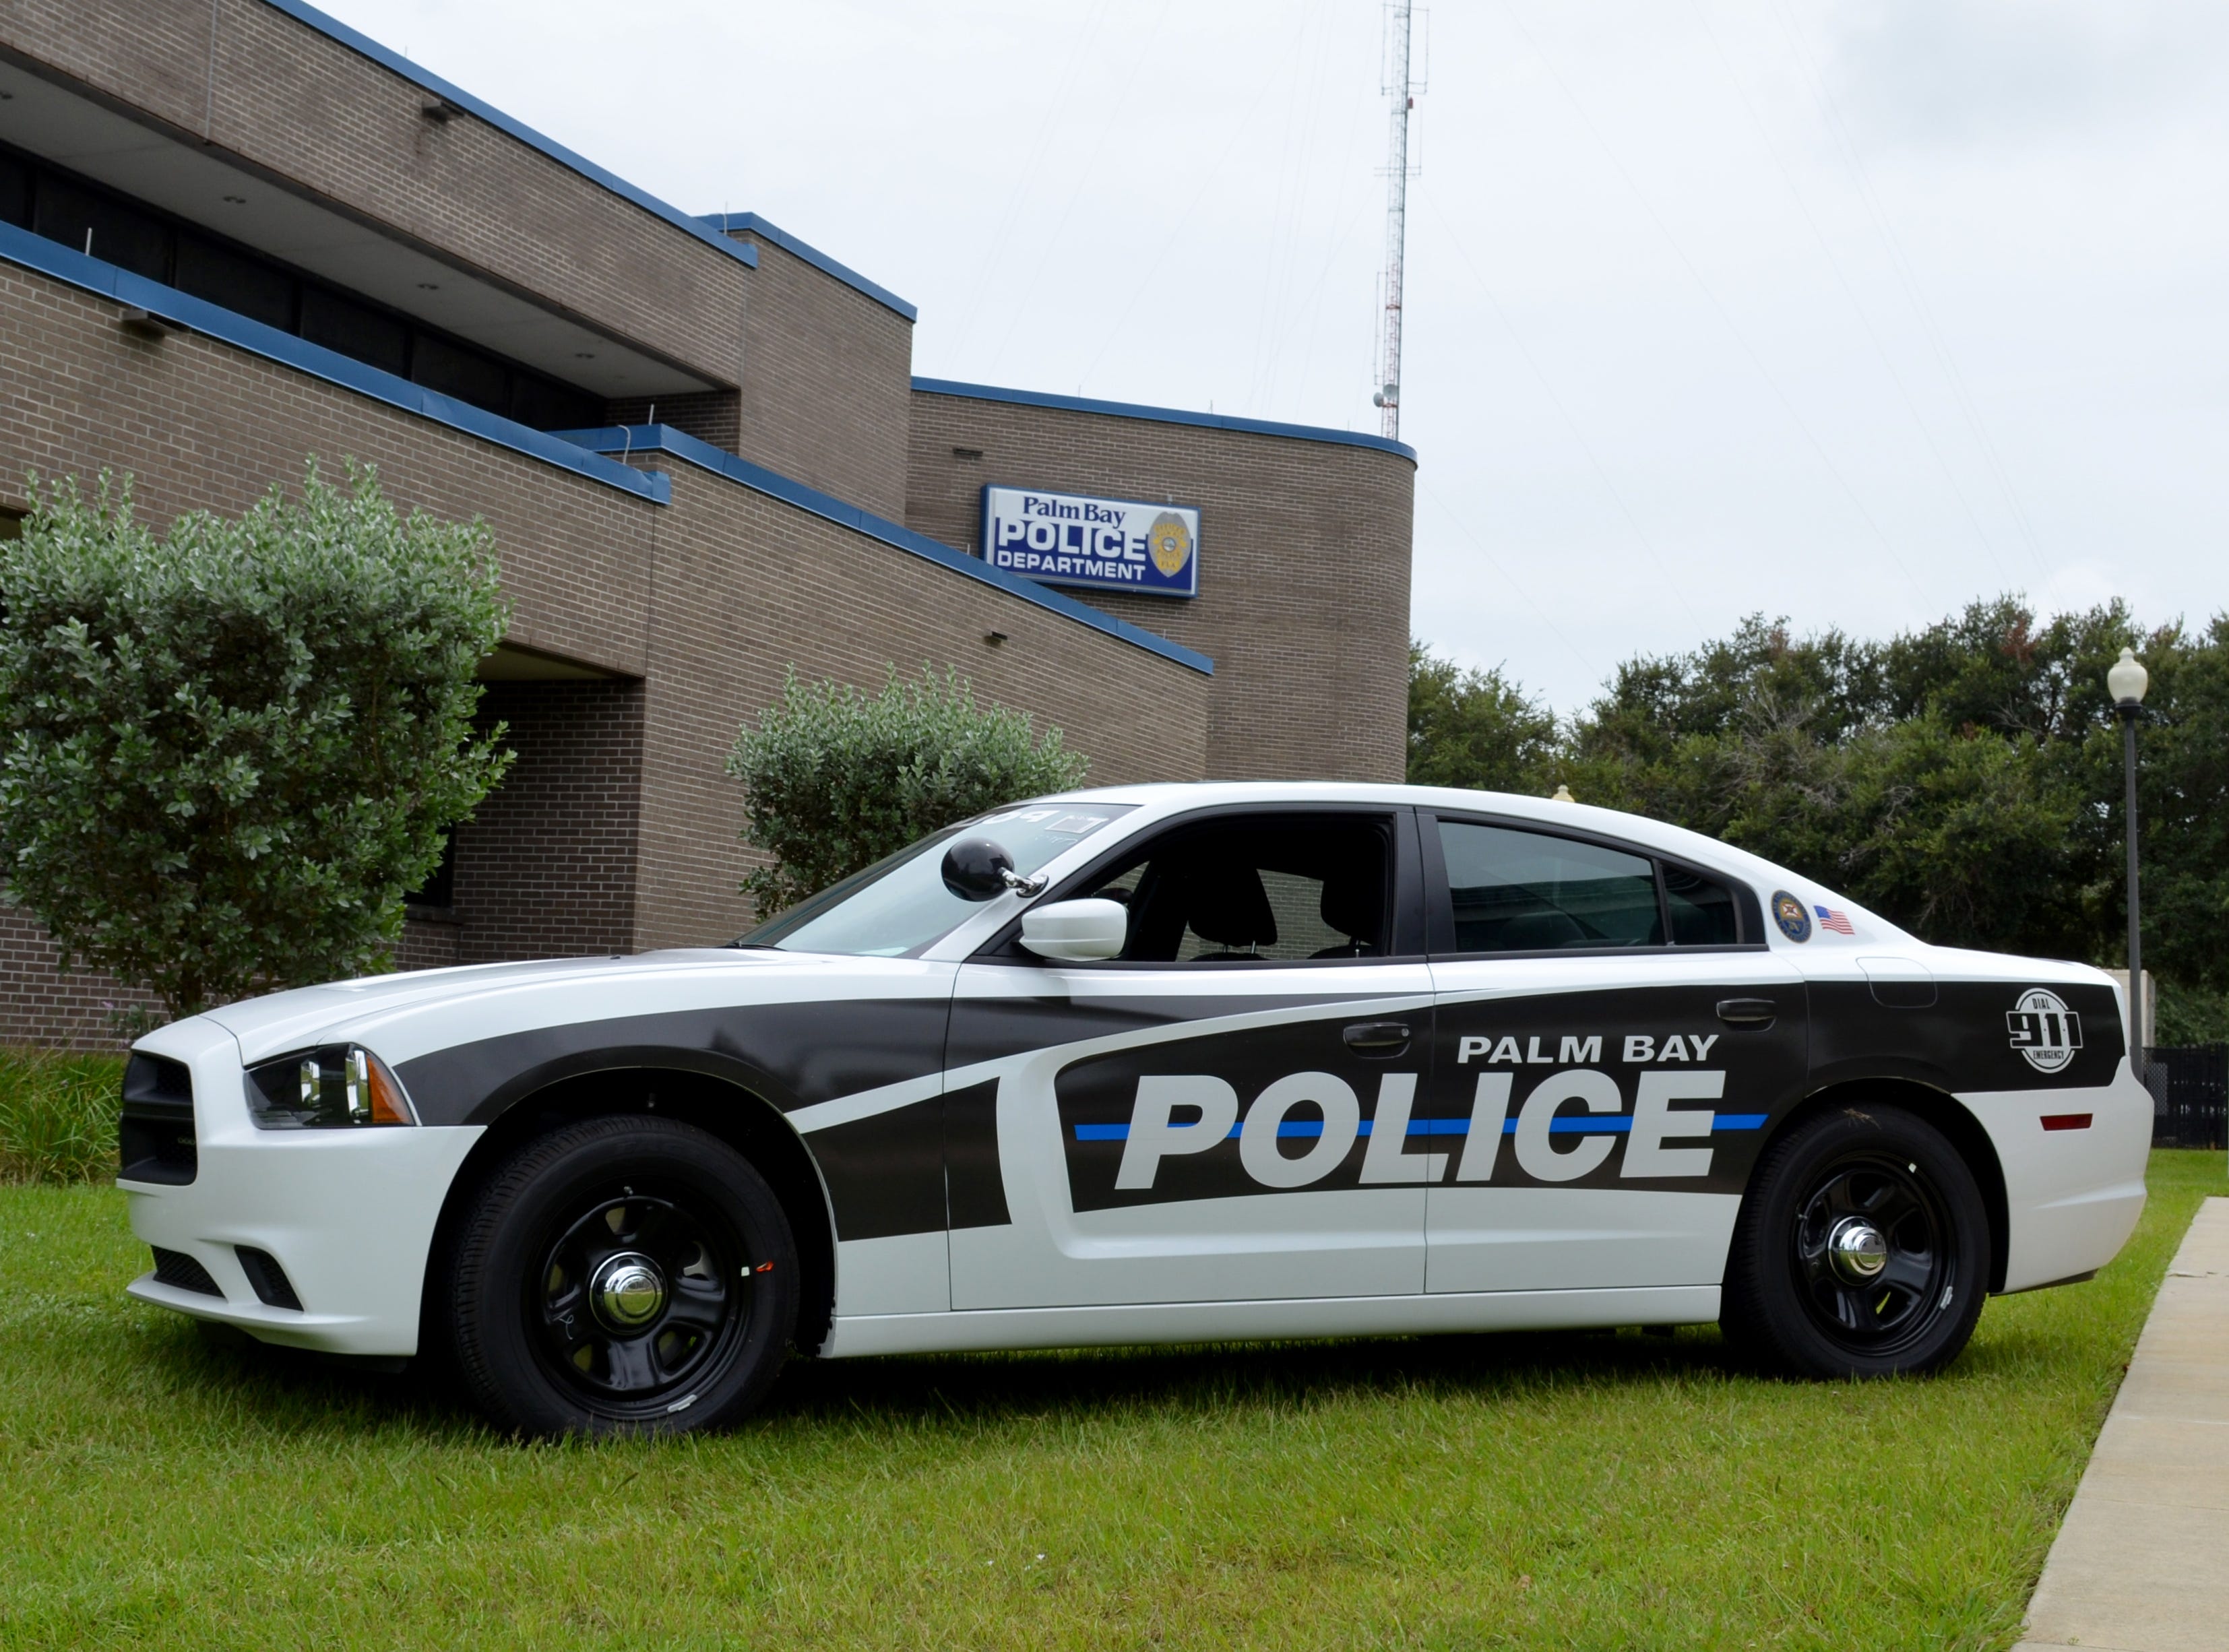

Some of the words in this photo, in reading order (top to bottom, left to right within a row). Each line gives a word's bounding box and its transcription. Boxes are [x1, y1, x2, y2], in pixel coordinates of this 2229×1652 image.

[1023, 496, 1081, 519] Palm
[1084, 503, 1127, 529] Bay
[997, 517, 1146, 562] POLICE
[997, 550, 1146, 580] DEPARTMENT
[2032, 998, 2050, 1010] DIAL
[1457, 1036, 1603, 1063] PALM
[1622, 1034, 1720, 1062] BAY
[2033, 1050, 2064, 1060] EMERGENCY
[1114, 1069, 1726, 1188] POLICE
